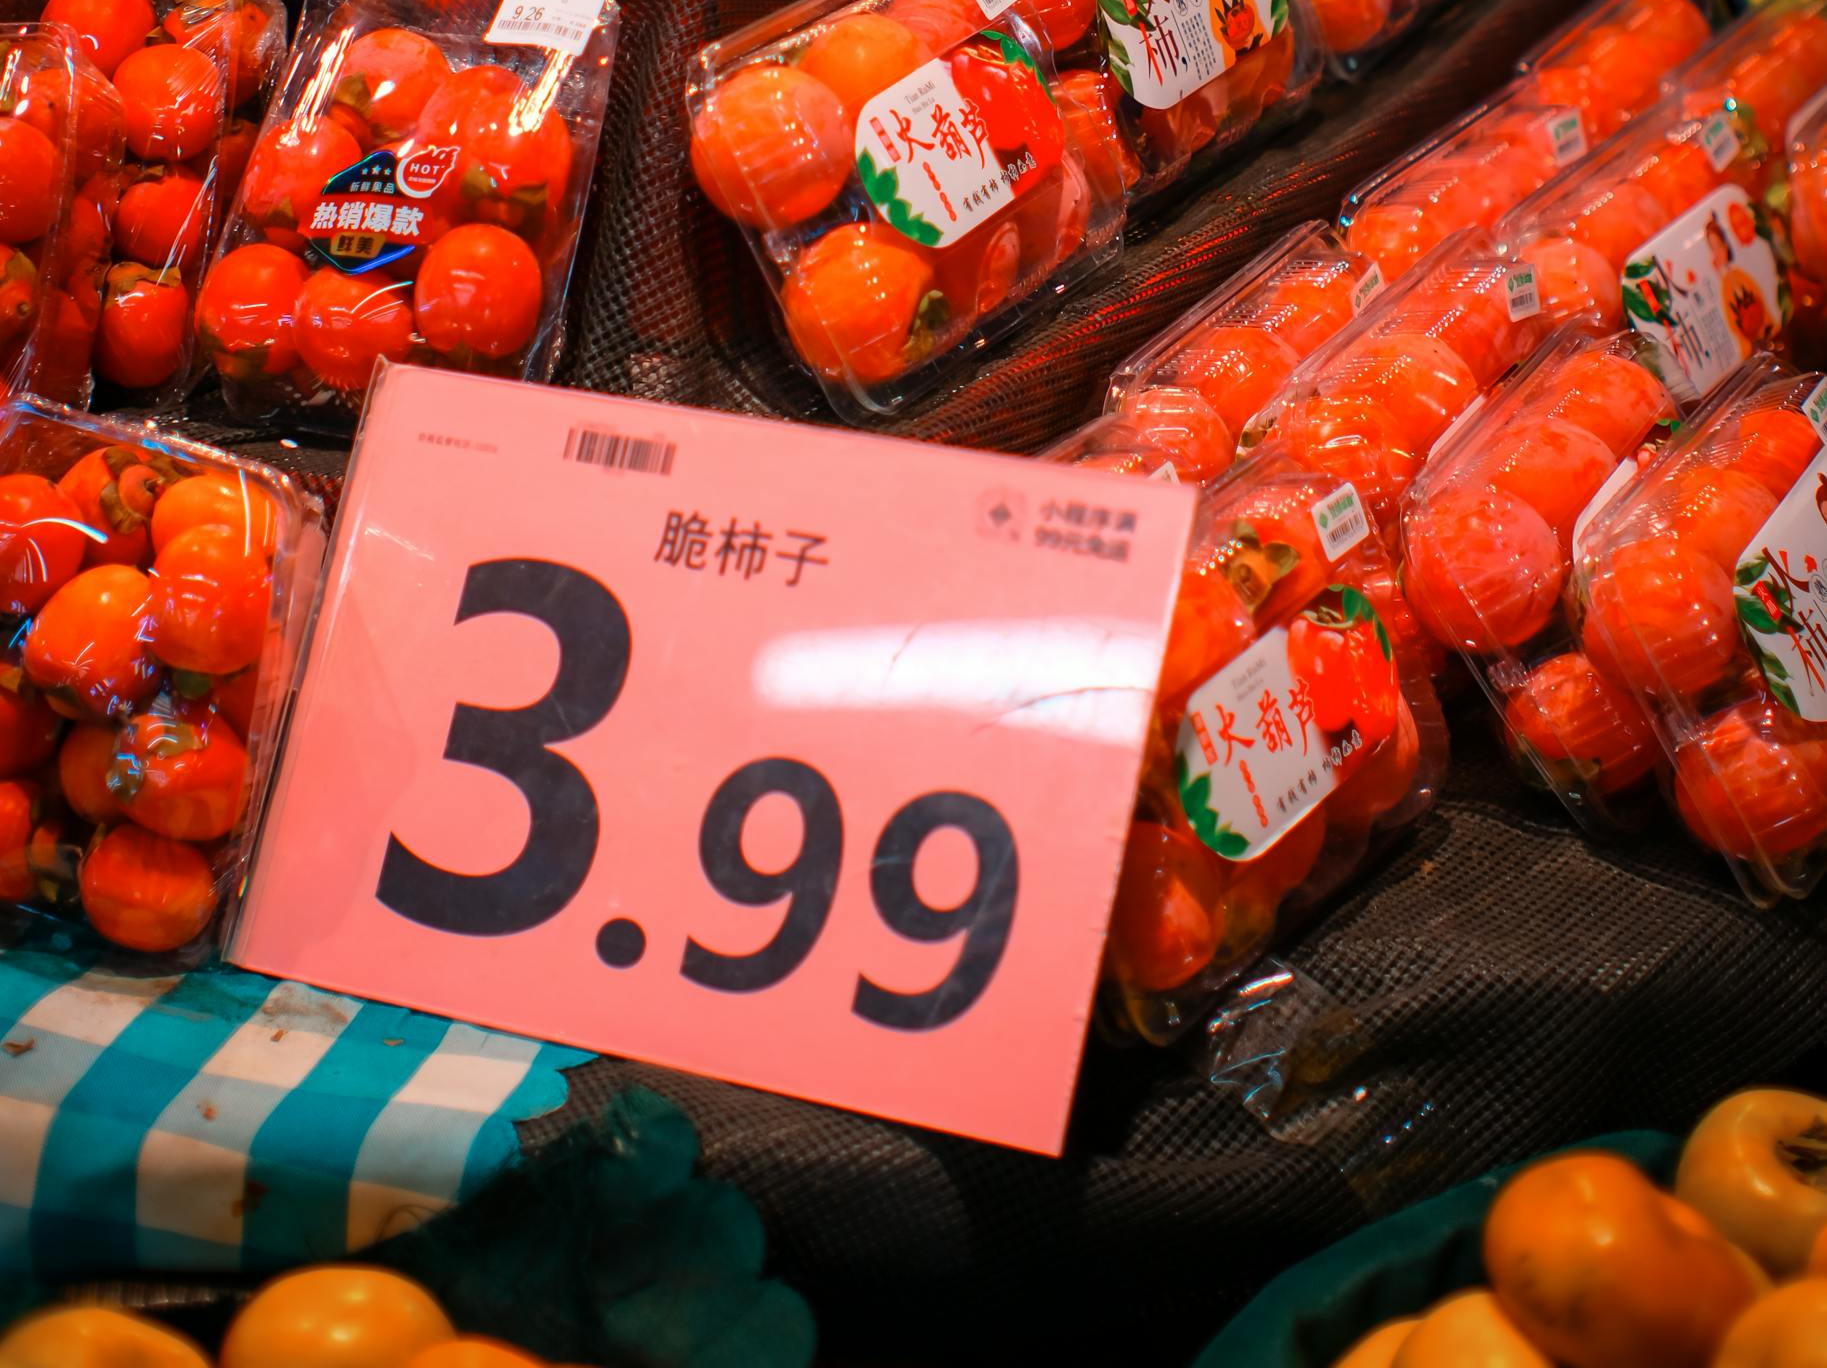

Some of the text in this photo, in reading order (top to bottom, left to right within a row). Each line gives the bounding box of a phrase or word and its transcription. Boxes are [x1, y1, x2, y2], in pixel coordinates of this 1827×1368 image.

[410, 163, 440, 175] HOT
[654, 509, 829, 587] 脆柿子
[375, 557, 1020, 1033] 3.99
